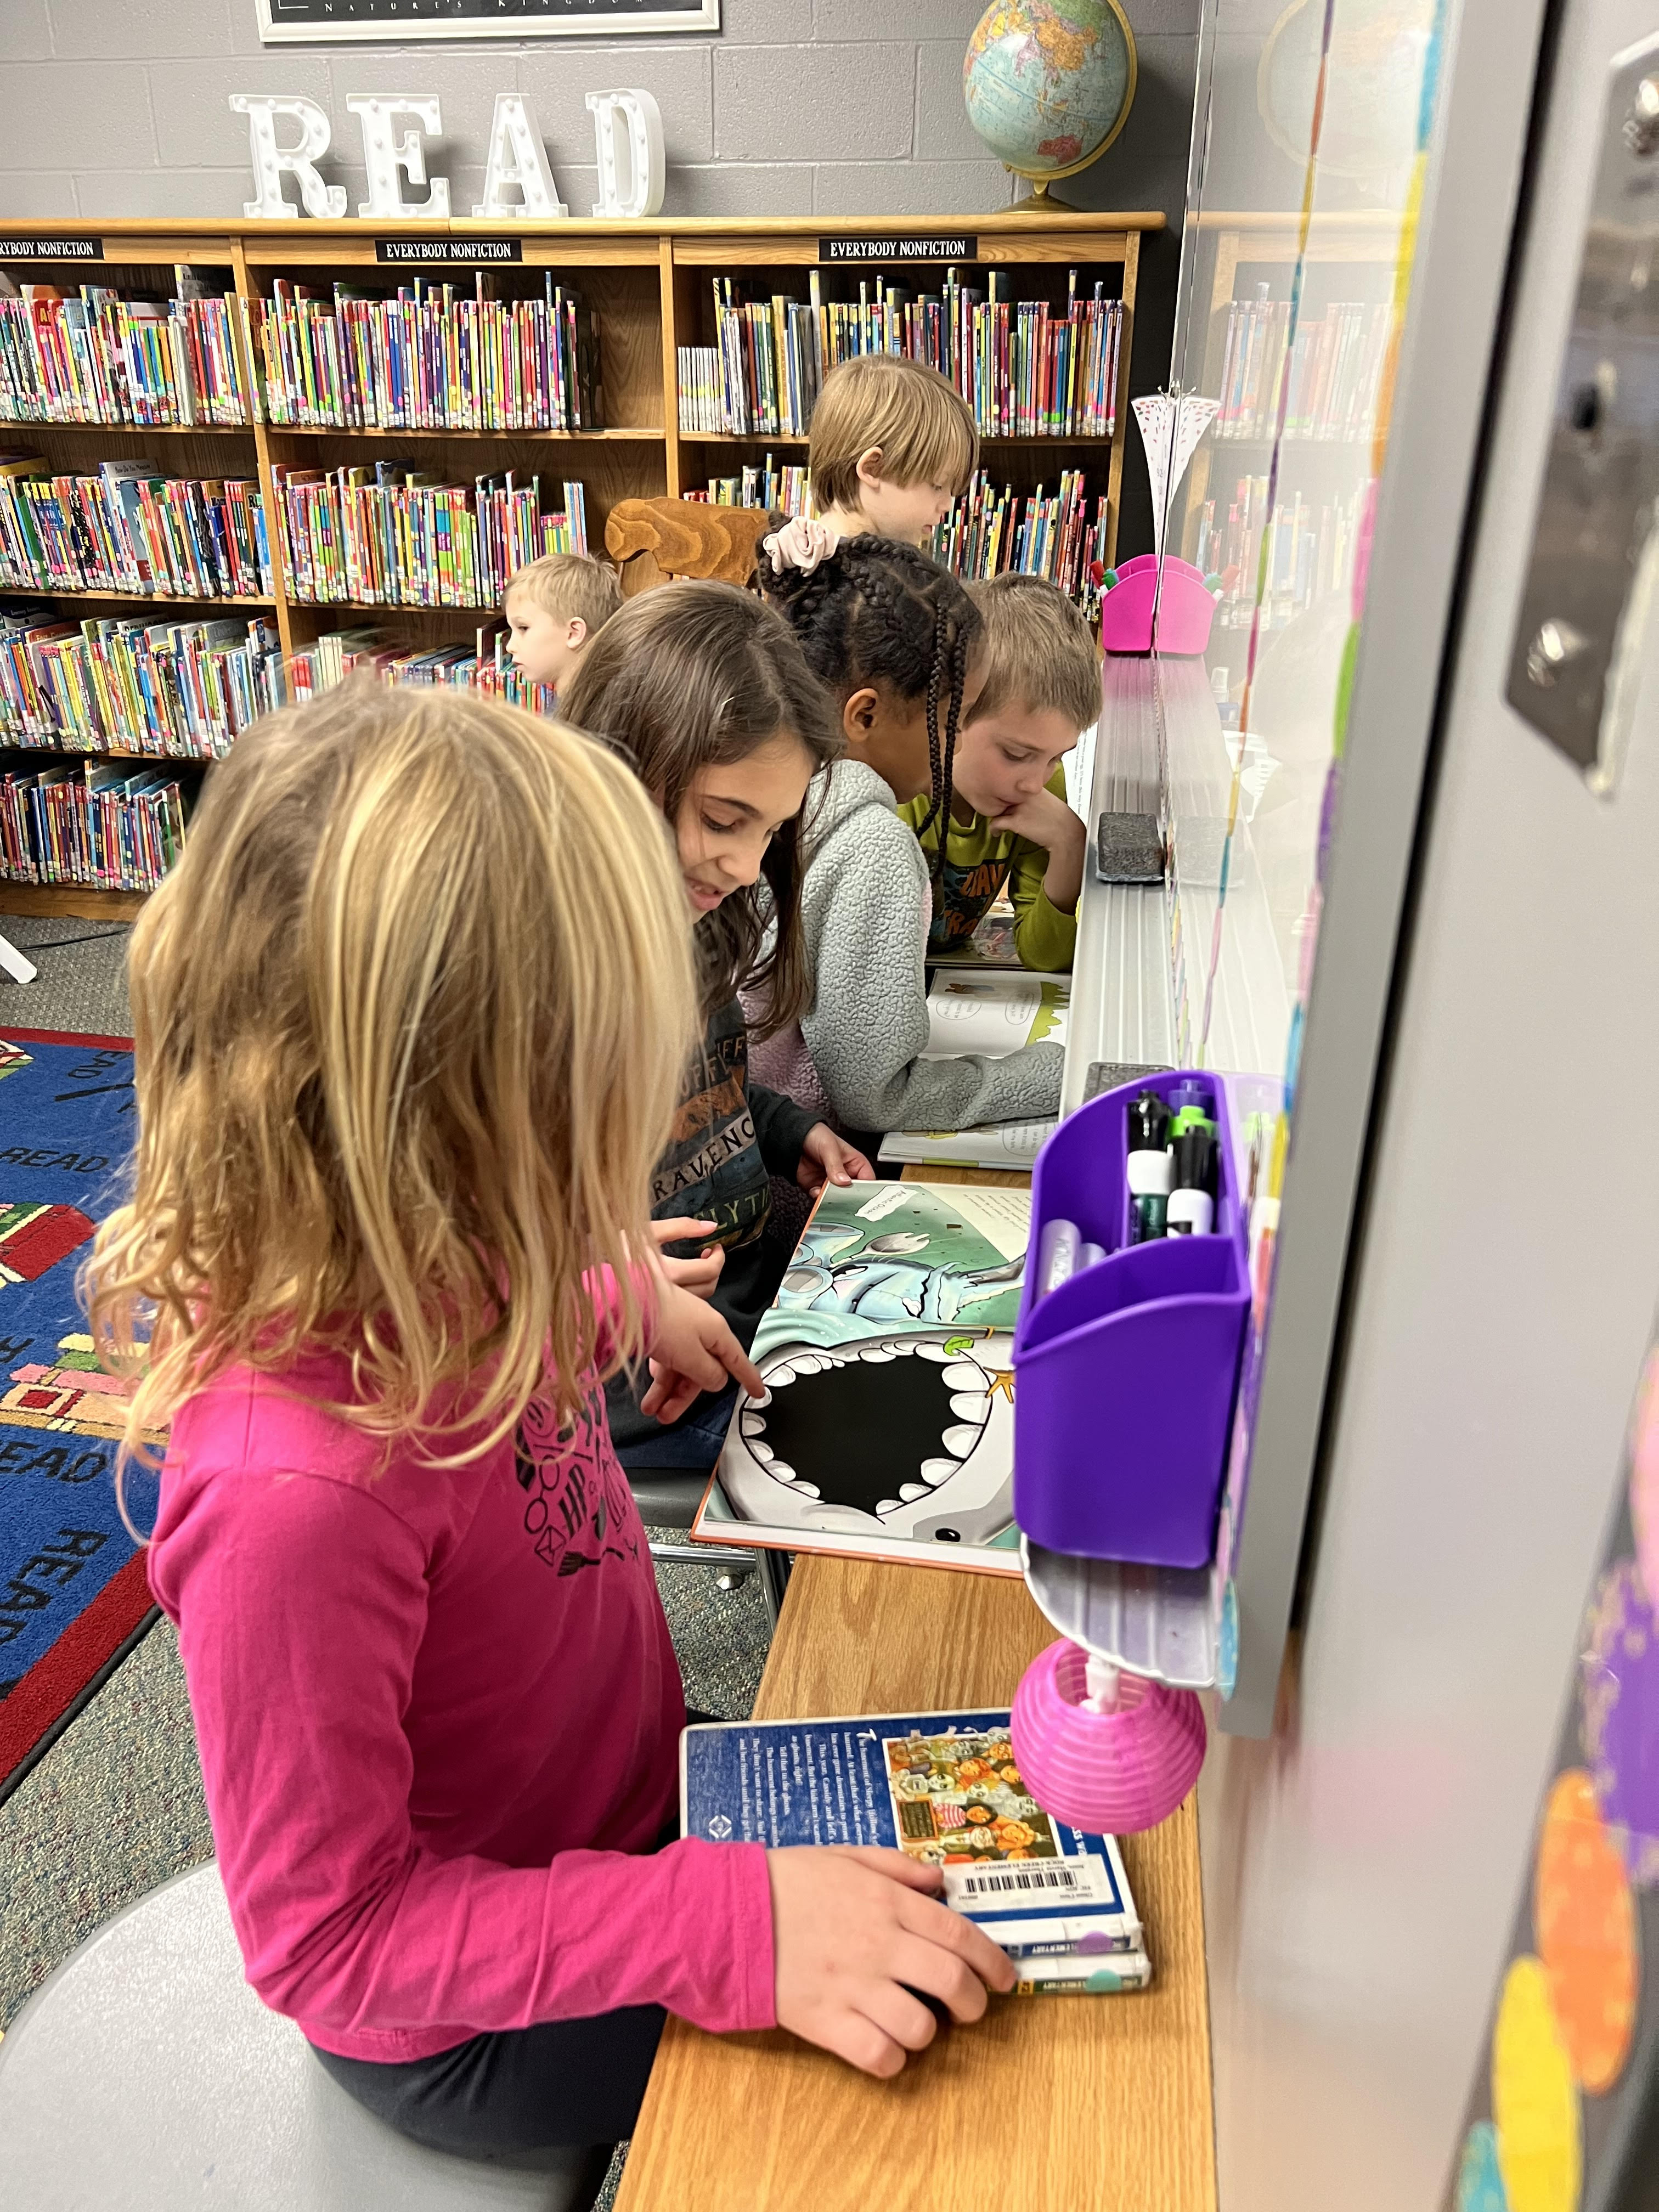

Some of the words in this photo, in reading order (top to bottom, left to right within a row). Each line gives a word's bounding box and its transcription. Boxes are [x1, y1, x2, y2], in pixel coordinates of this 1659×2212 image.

[228, 88, 665, 218] READ
[36, 242, 94, 255] NONFICTION
[386, 243, 447, 258] EVERYBODY
[450, 243, 511, 257] NONFICTION
[830, 242, 897, 257] EVERYBODY
[899, 240, 966, 256] NONFICTION
[0, 1147, 110, 1173] READ
[0, 1441, 107, 1483] EAD
[1032, 1943, 1077, 1954] LEMENTARY
